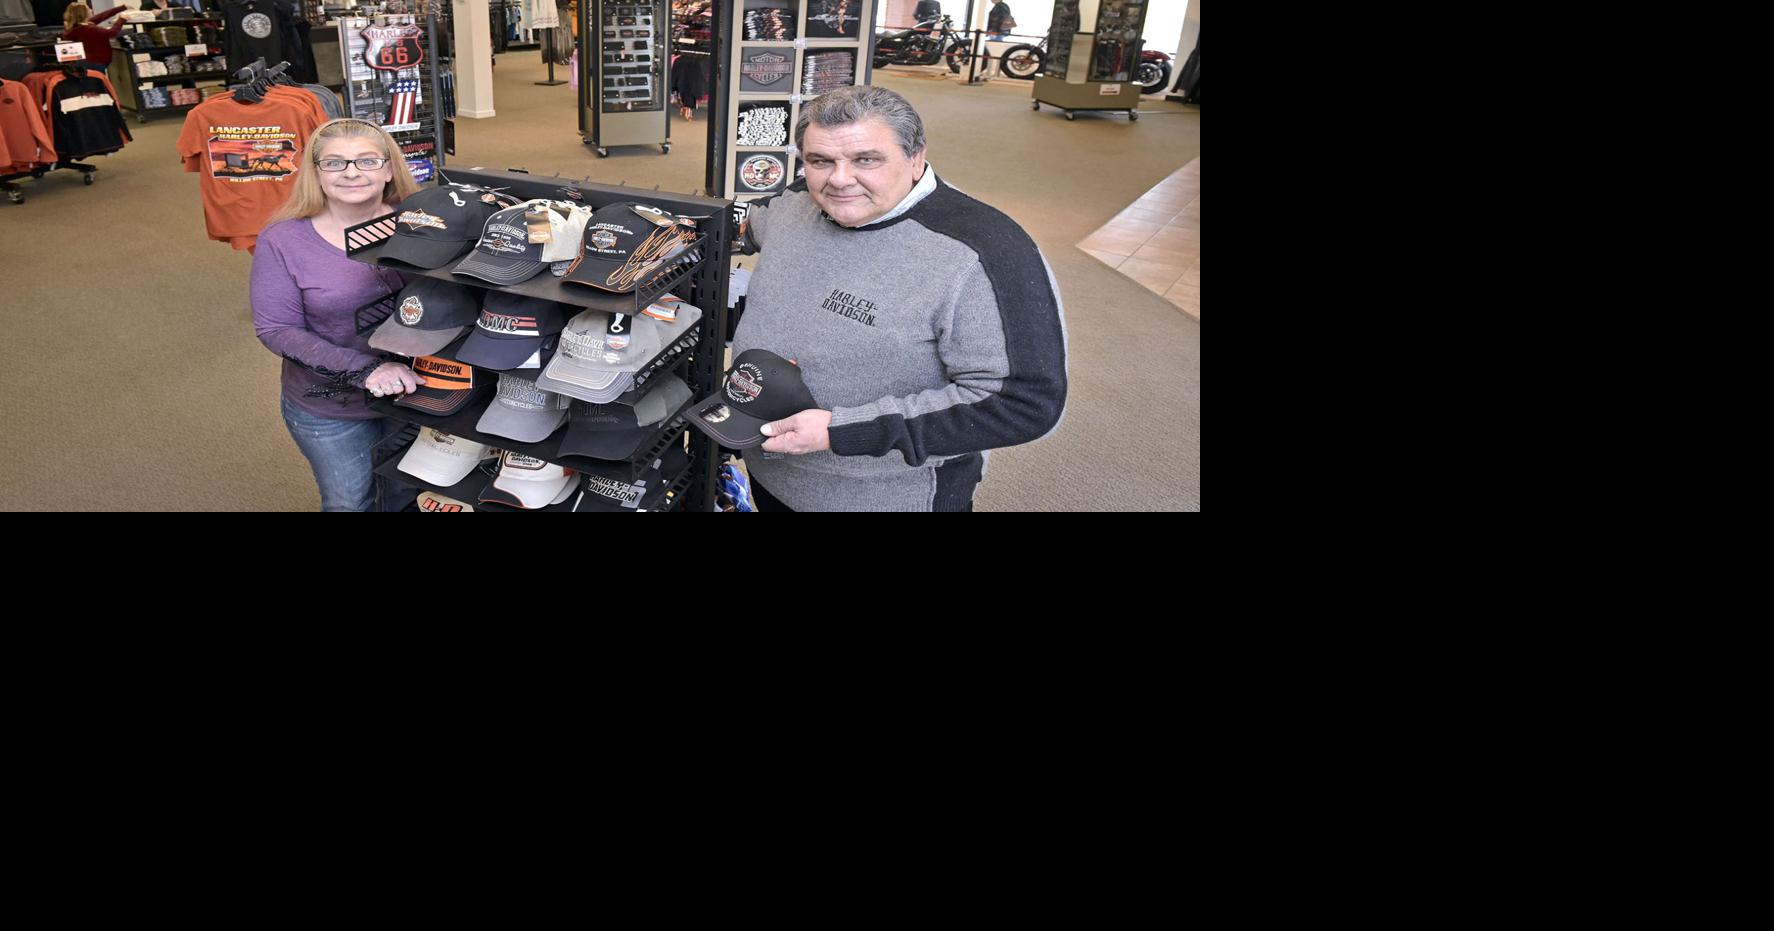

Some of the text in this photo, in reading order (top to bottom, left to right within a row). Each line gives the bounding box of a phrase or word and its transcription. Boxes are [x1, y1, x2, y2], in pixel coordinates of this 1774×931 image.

[381, 47, 409, 64] 66
[209, 126, 280, 134] LANCASTER
[829, 288, 878, 312] HARLEY-
[821, 298, 876, 327] DAVIDSON
[739, 363, 763, 381] GENUINE
[588, 481, 639, 502] DAVIDSON
